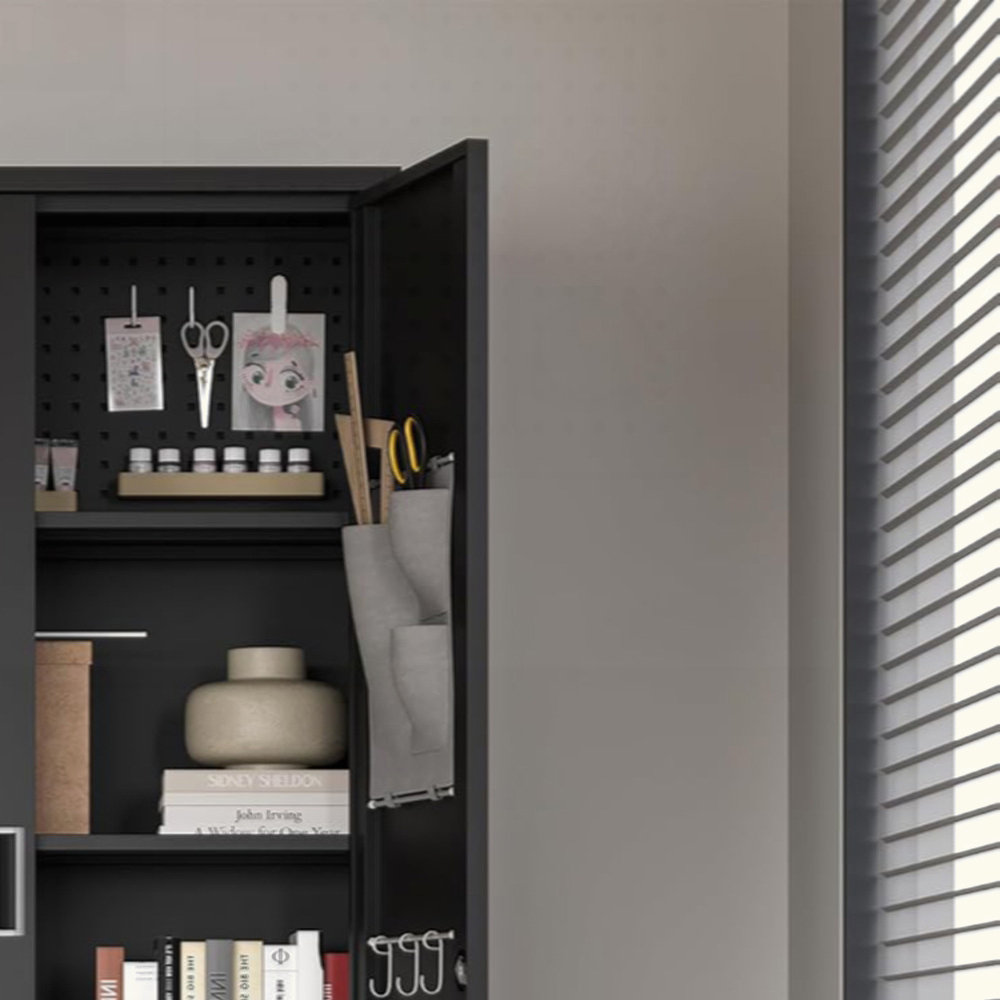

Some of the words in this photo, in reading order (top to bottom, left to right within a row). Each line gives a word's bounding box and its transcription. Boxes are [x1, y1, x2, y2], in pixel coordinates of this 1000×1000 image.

[207, 774, 254, 788] SIDNEY
[258, 774, 323, 788] SHELDON
[235, 808, 263, 823] John
[266, 808, 303, 823] Irving
